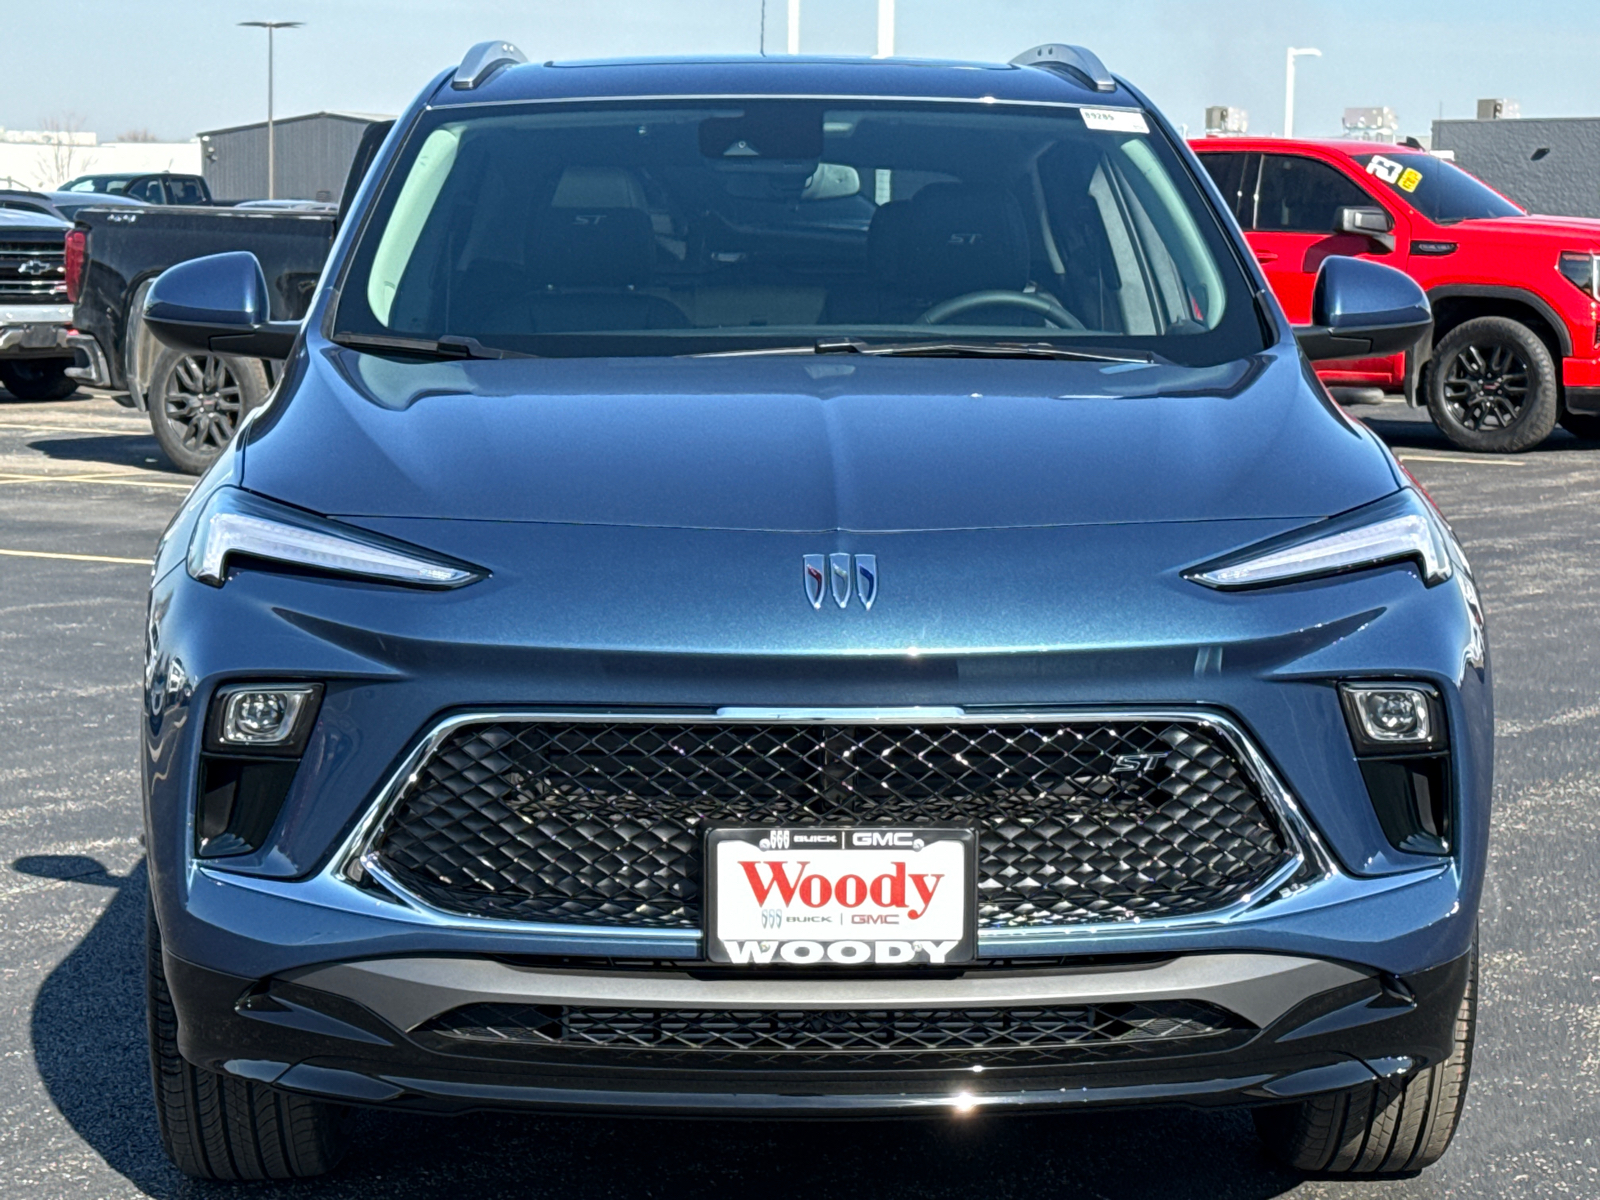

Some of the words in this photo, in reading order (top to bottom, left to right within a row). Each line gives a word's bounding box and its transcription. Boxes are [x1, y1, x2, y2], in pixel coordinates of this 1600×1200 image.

[573, 214, 608, 225] ST
[948, 233, 982, 243] ST
[1110, 752, 1169, 773] ST
[793, 834, 838, 843] BUICK
[852, 832, 914, 847] GMC
[737, 860, 946, 920] Woody
[786, 915, 833, 924] BUICK
[851, 914, 900, 925] GMC
[723, 940, 959, 964] WOODY
